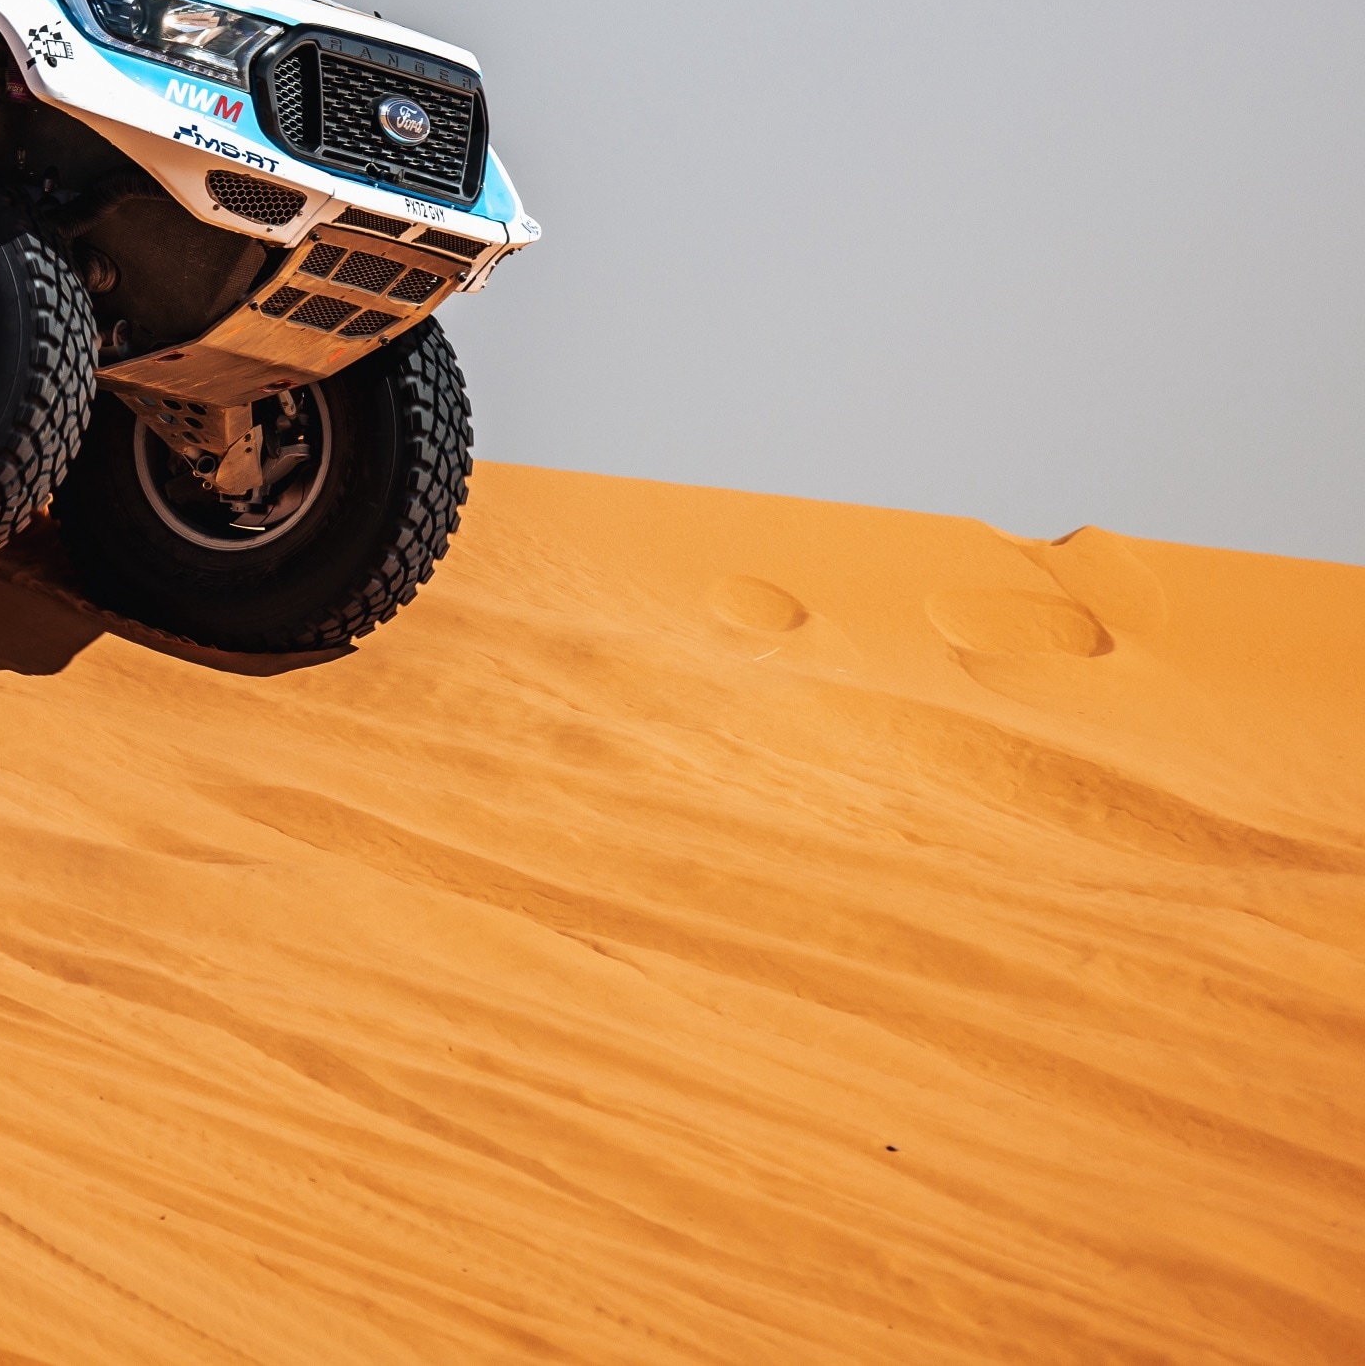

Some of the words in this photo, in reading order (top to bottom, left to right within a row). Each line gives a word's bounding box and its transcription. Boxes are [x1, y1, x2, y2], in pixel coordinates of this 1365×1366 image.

[329, 36, 473, 90] RANGER
[164, 78, 244, 123] NWM
[396, 105, 424, 134] Ford
[194, 132, 280, 173] MS-RT
[405, 197, 428, 218] PX72
[430, 209, 446, 222] GVY
